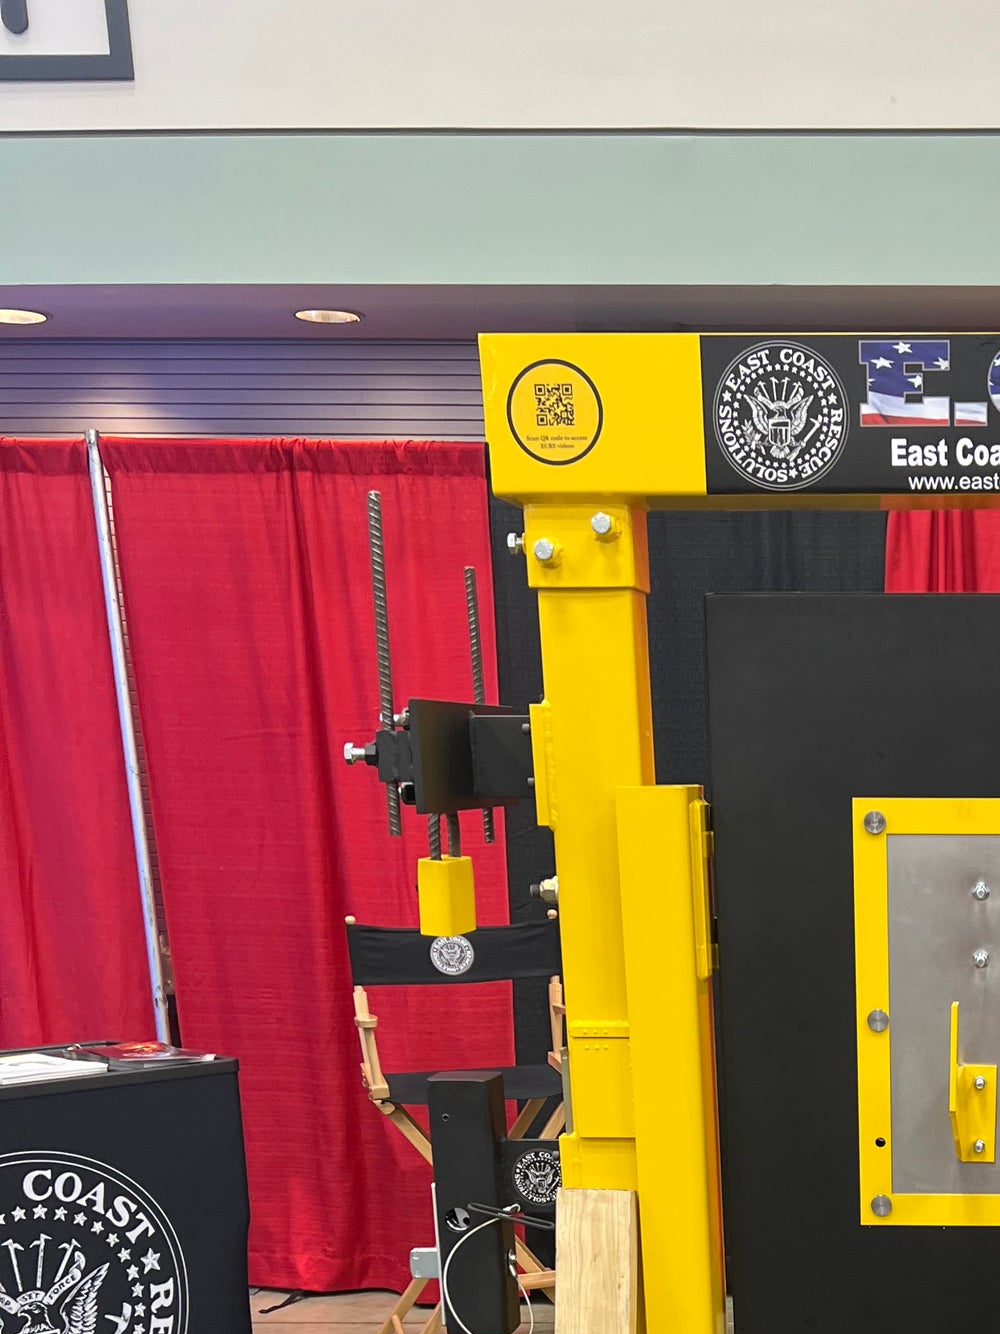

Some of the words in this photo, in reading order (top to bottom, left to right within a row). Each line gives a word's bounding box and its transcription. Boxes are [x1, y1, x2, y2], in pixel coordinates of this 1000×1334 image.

[725, 349, 770, 391] EAST
[780, 349, 835, 390] COAST
[719, 405, 788, 482] SOLUTIONS
[799, 408, 843, 478] RESCUE
[890, 438, 949, 467] East
[516, 1152, 536, 1169] EAST
[22, 1169, 156, 1244] COAST
[22, 1292, 40, 1301] SET
[48, 1273, 77, 1300] FORCE
